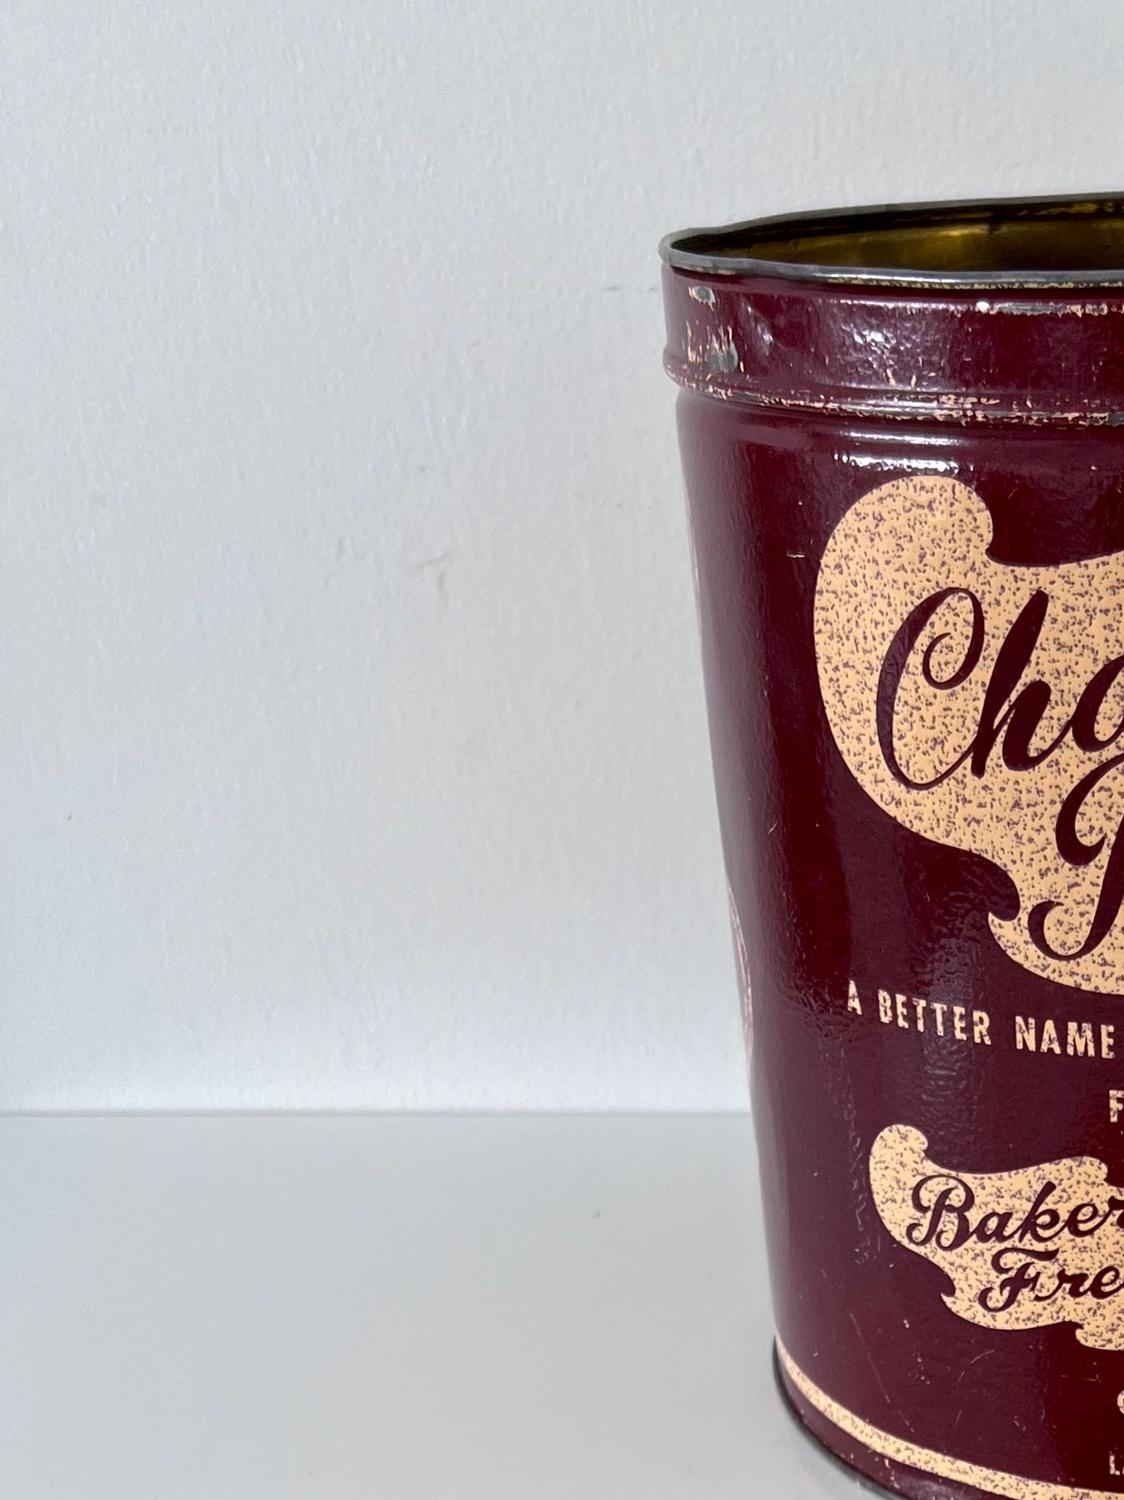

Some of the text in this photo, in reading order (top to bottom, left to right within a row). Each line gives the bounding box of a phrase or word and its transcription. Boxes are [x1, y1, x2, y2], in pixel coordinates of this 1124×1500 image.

[846, 979, 1117, 1060] A BETTER NAME
